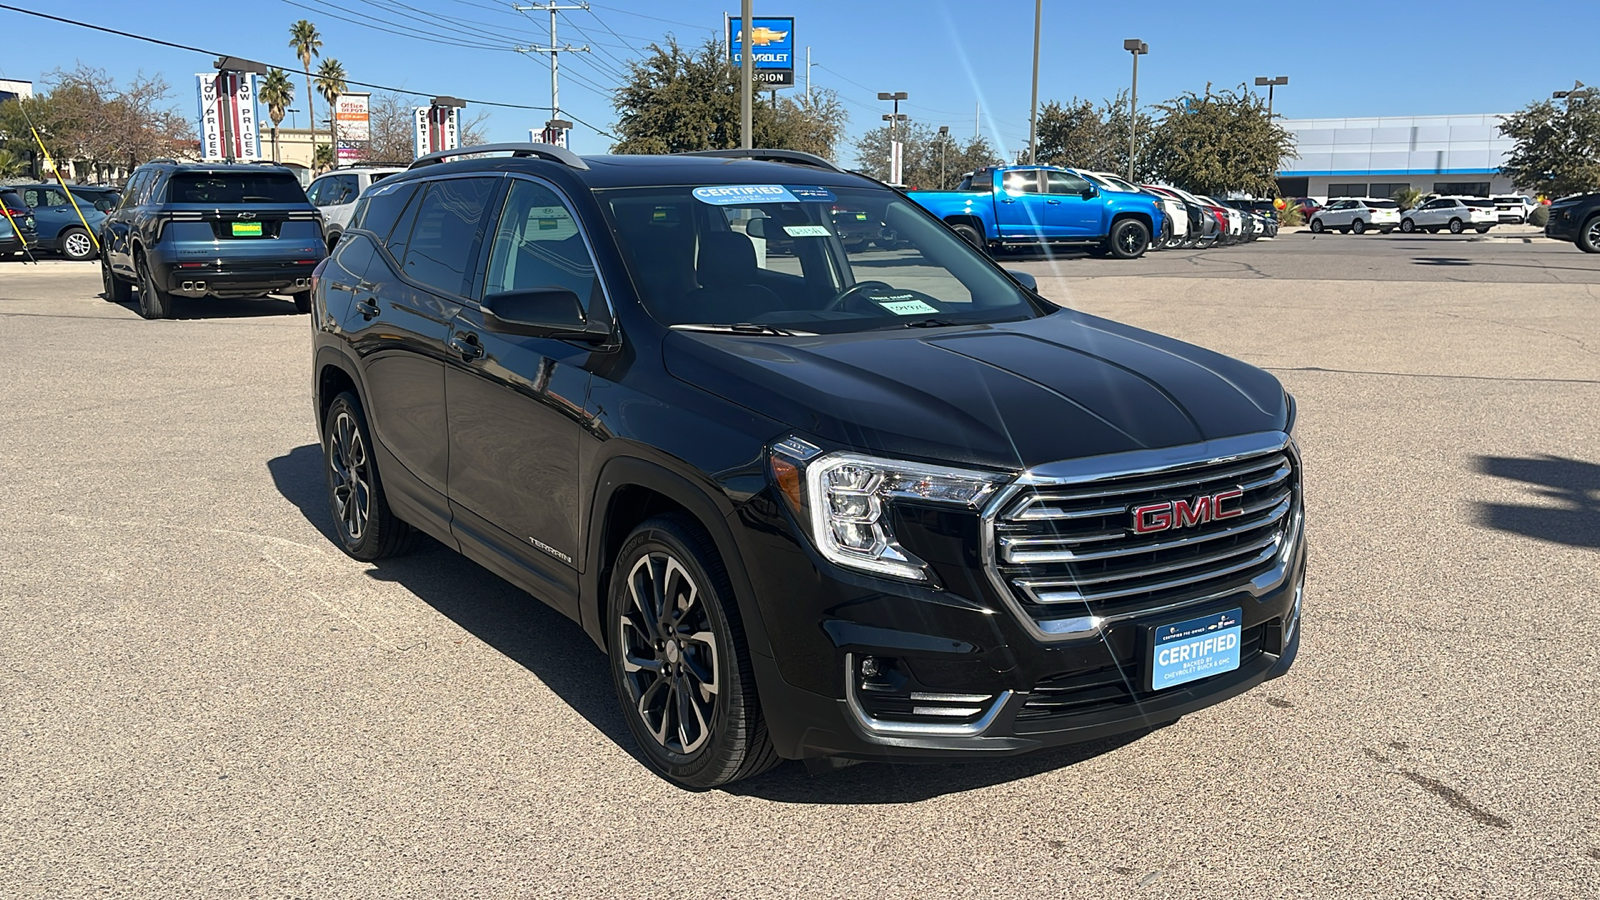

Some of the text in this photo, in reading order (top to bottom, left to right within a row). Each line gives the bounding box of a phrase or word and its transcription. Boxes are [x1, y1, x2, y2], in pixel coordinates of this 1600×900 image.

[734, 53, 789, 62] CVROLET
[752, 73, 784, 82] SSION
[204, 77, 218, 157] LOW PRICES
[239, 76, 254, 156] LOW PRICES
[447, 109, 456, 150] CERTIF
[419, 109, 427, 156] CERTIFI
[696, 185, 784, 198] CERTIFIED
[1131, 489, 1244, 535] GMC
[529, 536, 572, 564] TERRAIN
[1158, 633, 1237, 667] CERTIFIED
[1183, 656, 1213, 669] BACKED BY
[1164, 666, 1196, 680] CHEVROLET
[1197, 662, 1213, 672] BUICK
[1218, 657, 1231, 666] GMC
